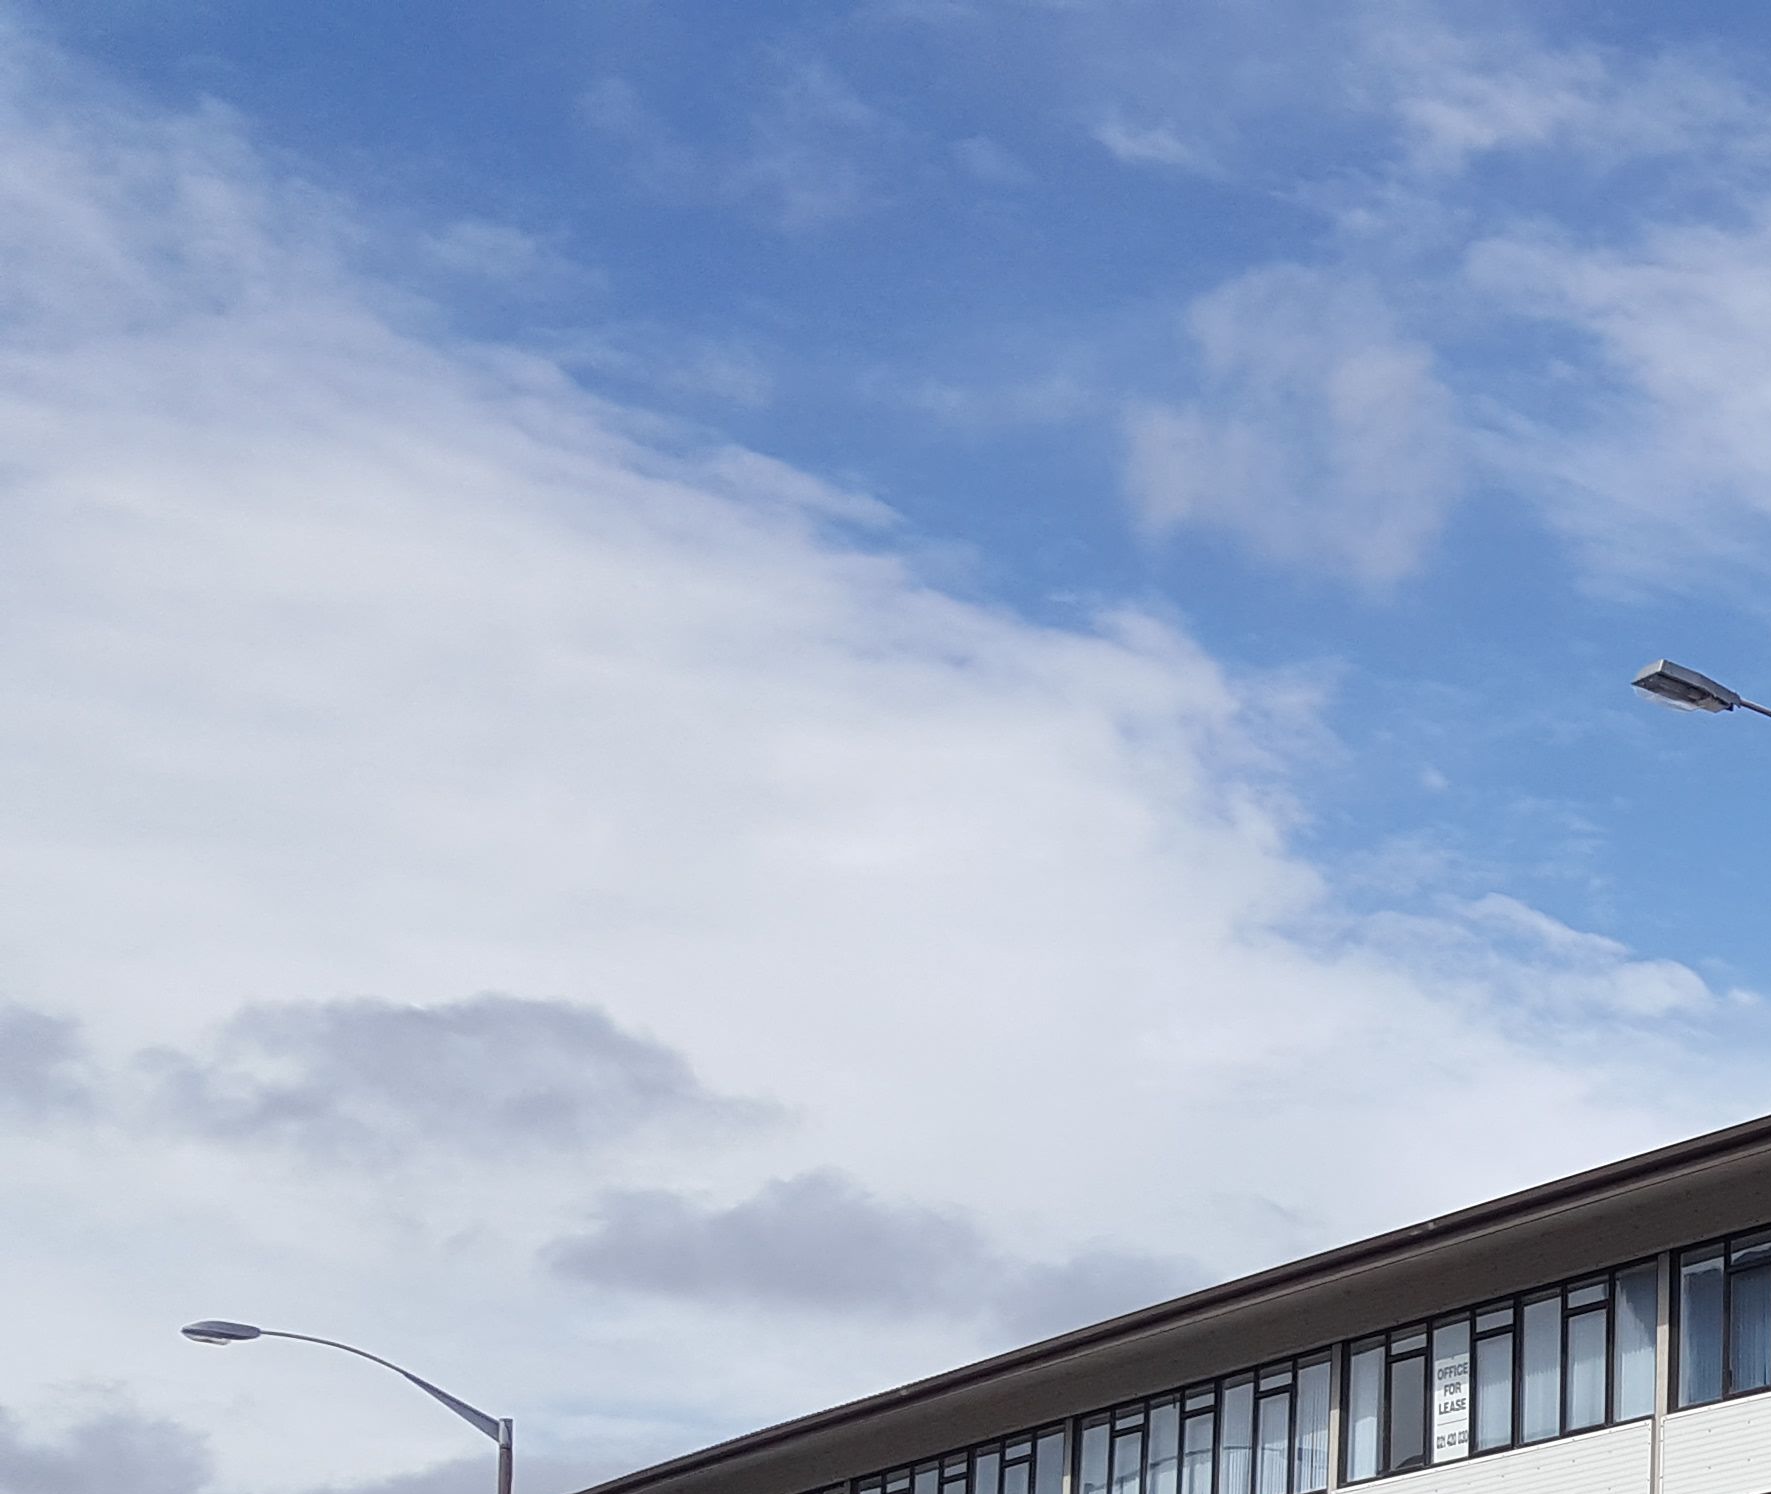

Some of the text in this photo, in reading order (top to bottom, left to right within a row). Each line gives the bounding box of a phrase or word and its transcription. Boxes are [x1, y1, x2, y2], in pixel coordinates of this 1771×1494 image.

[1437, 1362, 1468, 1380] OFFICE
[1444, 1382, 1461, 1396] FOR
[1438, 1398, 1466, 1415] LEASE
